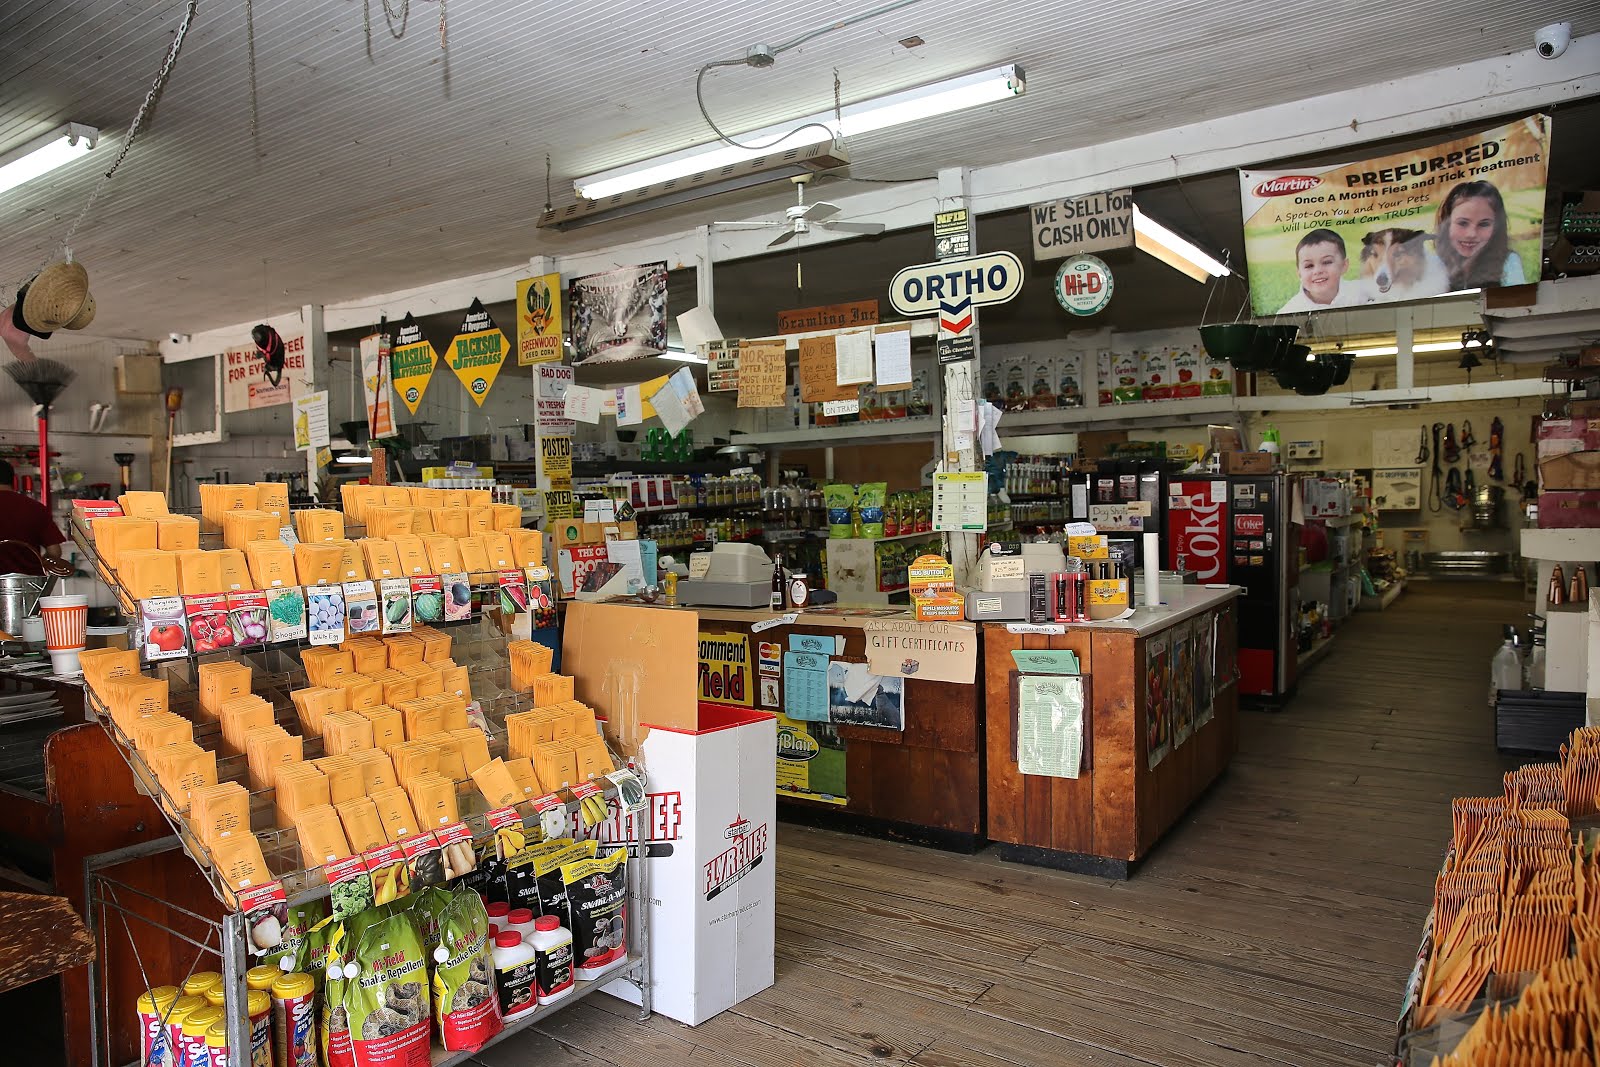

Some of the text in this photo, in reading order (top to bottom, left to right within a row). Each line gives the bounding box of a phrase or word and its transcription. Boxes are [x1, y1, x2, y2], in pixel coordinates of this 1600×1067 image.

[1260, 176, 1319, 195] Martin's
[1294, 153, 1540, 205] Once A Month Flea and Tick Treatment
[1034, 192, 1132, 224] WE SELL FOR
[1275, 194, 1430, 223] A Spot-On You and Your Pets
[936, 210, 966, 224] NFIB
[1282, 206, 1423, 233] Will LOVE and Can TRUST
[1038, 215, 1130, 248] CASH ONLY
[904, 264, 1008, 302] ORTHO
[1065, 272, 1102, 296] Hi-D
[779, 312, 846, 330] Gramling
[453, 333, 501, 370] JACKSON
[522, 338, 558, 352] GREENWOOD
[802, 347, 814, 358] NO
[228, 352, 242, 365] WE
[463, 353, 502, 368] RYEGRASS
[740, 350, 755, 362] NO
[228, 368, 246, 384] FOR
[402, 364, 432, 378] RYEGRASS
[542, 368, 571, 380] BAD DOG
[740, 364, 761, 373] AFTER
[740, 374, 782, 384] MUST HAVE
[538, 400, 544, 409] NO
[838, 404, 858, 412] TRAPS
[542, 438, 570, 457] POSTED
[544, 490, 572, 506] POSTED
[1093, 506, 1108, 520] Dog
[1238, 518, 1263, 530] Coke
[1185, 493, 1220, 579] Coke
[578, 548, 594, 558] THE
[275, 628, 304, 640] Shogoin
[328, 632, 339, 640] Egg
[868, 622, 949, 634] ASK ABOUT OUR
[872, 636, 965, 652] GIFT CERTIFICATES
[704, 824, 768, 894] FLYRELIEF
[372, 951, 405, 972] Hi-Yield
[446, 950, 469, 968] Snake
[360, 958, 426, 988] Snake Repellent
